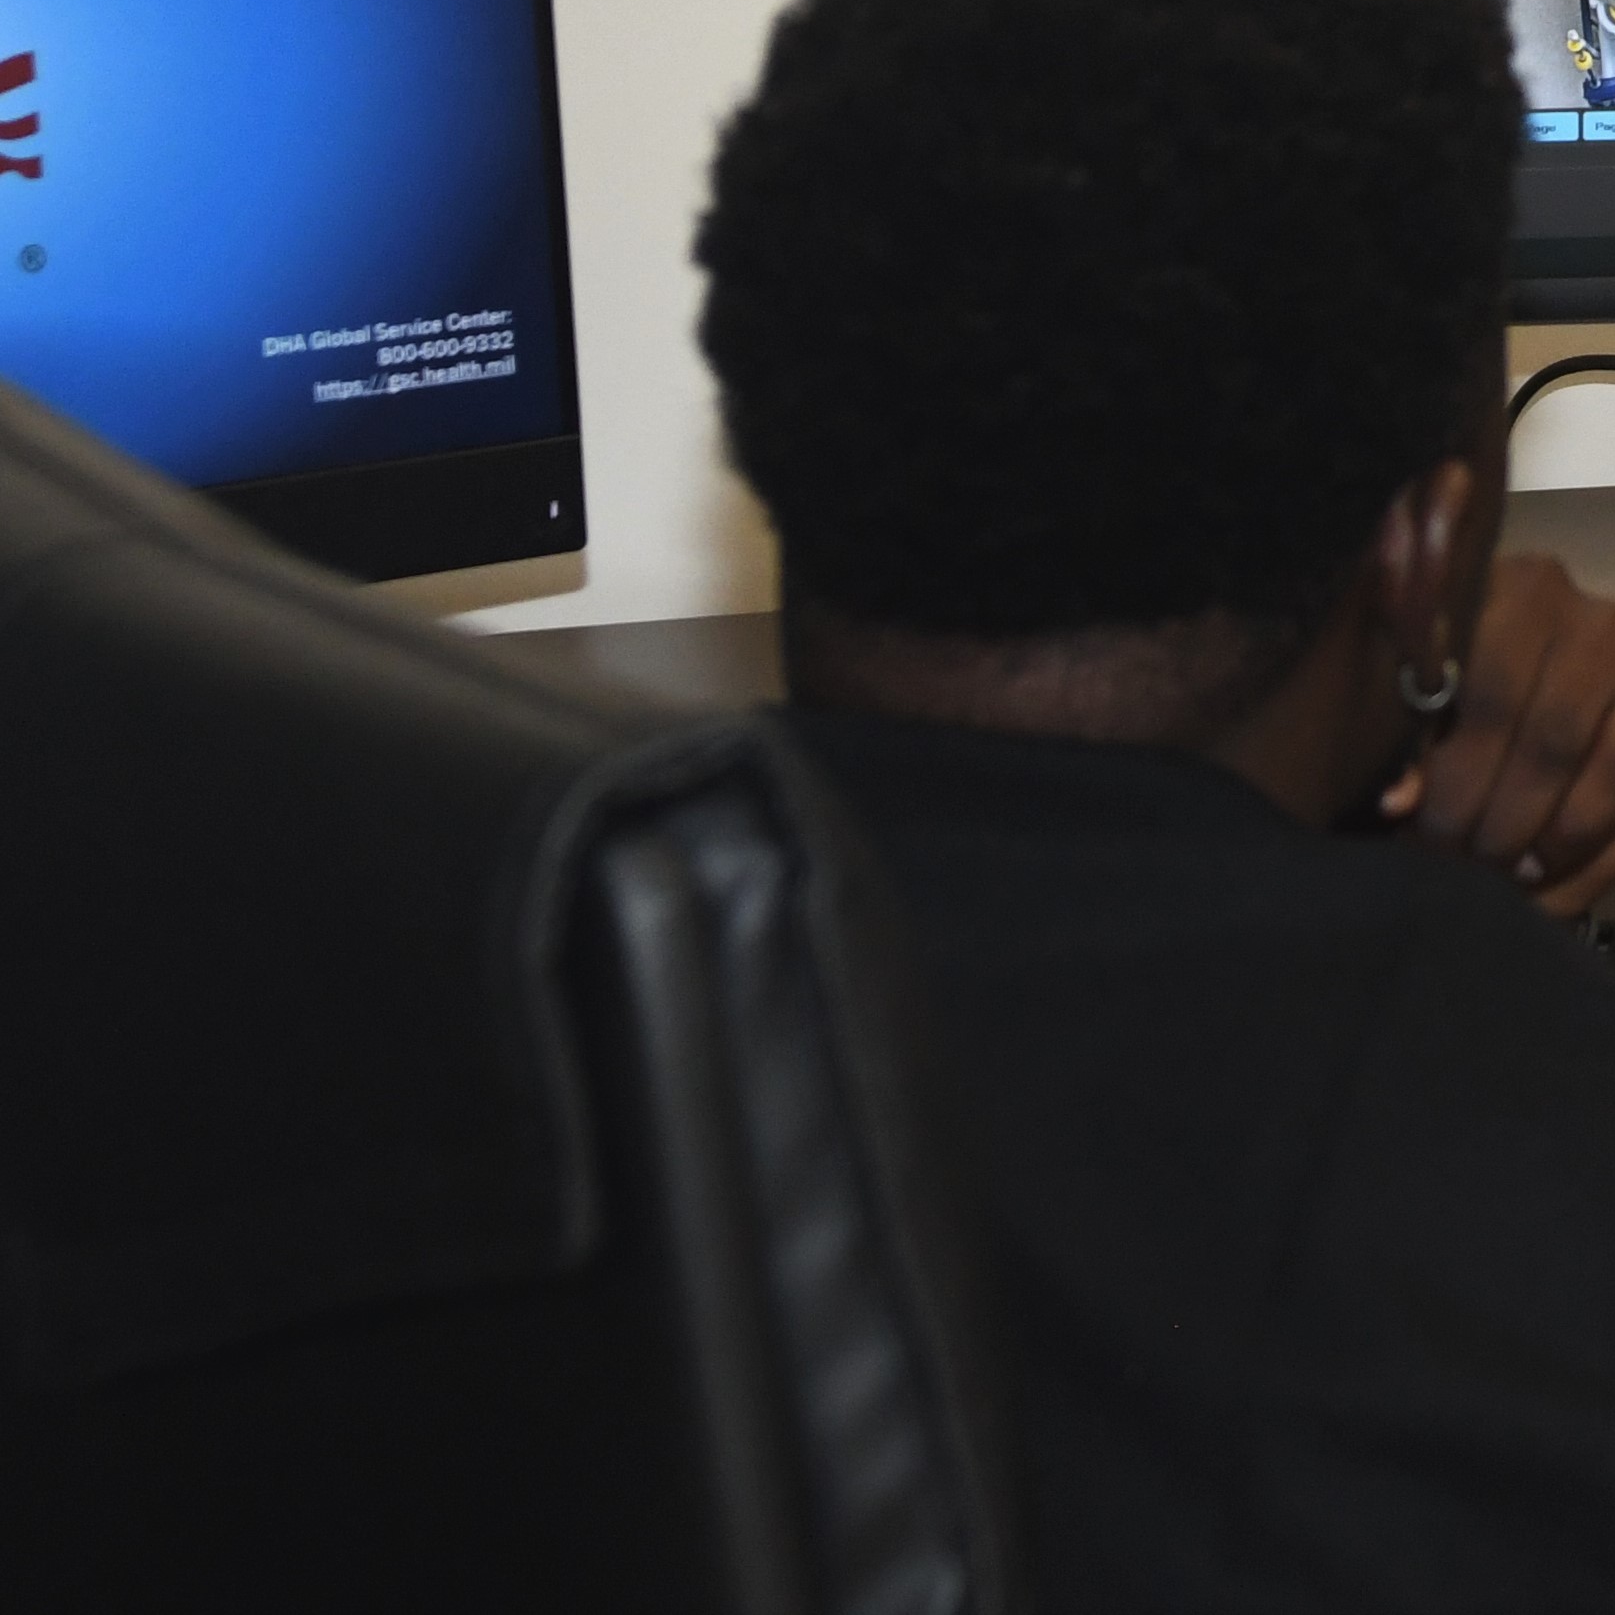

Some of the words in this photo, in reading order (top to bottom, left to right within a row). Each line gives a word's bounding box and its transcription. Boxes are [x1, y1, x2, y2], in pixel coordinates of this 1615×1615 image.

[262, 333, 307, 359] DHA
[309, 324, 371, 351] Global
[373, 317, 444, 342] Service
[445, 310, 513, 331] Center:
[376, 330, 515, 367] 800-600-9332
